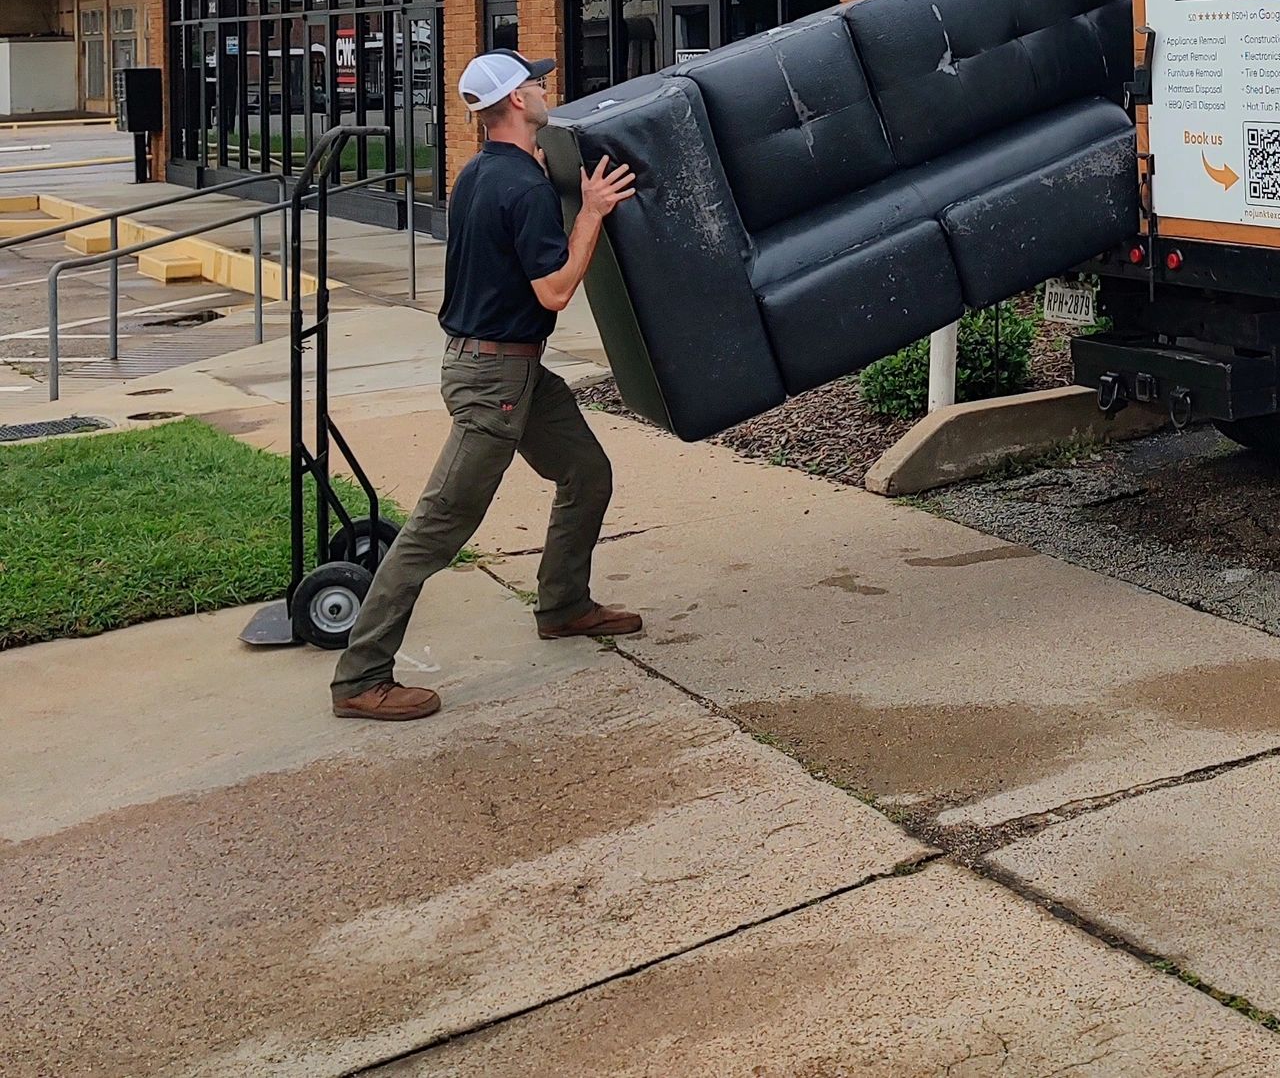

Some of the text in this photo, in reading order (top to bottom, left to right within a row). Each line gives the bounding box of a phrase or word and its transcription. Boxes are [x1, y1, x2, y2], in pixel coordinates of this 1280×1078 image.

[1199, 35, 1227, 45] Removal
[1167, 51, 1217, 62] Carpet Removal
[1167, 68, 1223, 78] Furniture Removal
[1245, 68, 1258, 77] Tire
[1195, 84, 1222, 95] Disposal
[1245, 85, 1263, 95] Shed
[1198, 100, 1226, 111] Disposal
[1246, 102, 1259, 111] Hot
[1260, 102, 1273, 111] Tub
[1184, 130, 1223, 146] Book us
